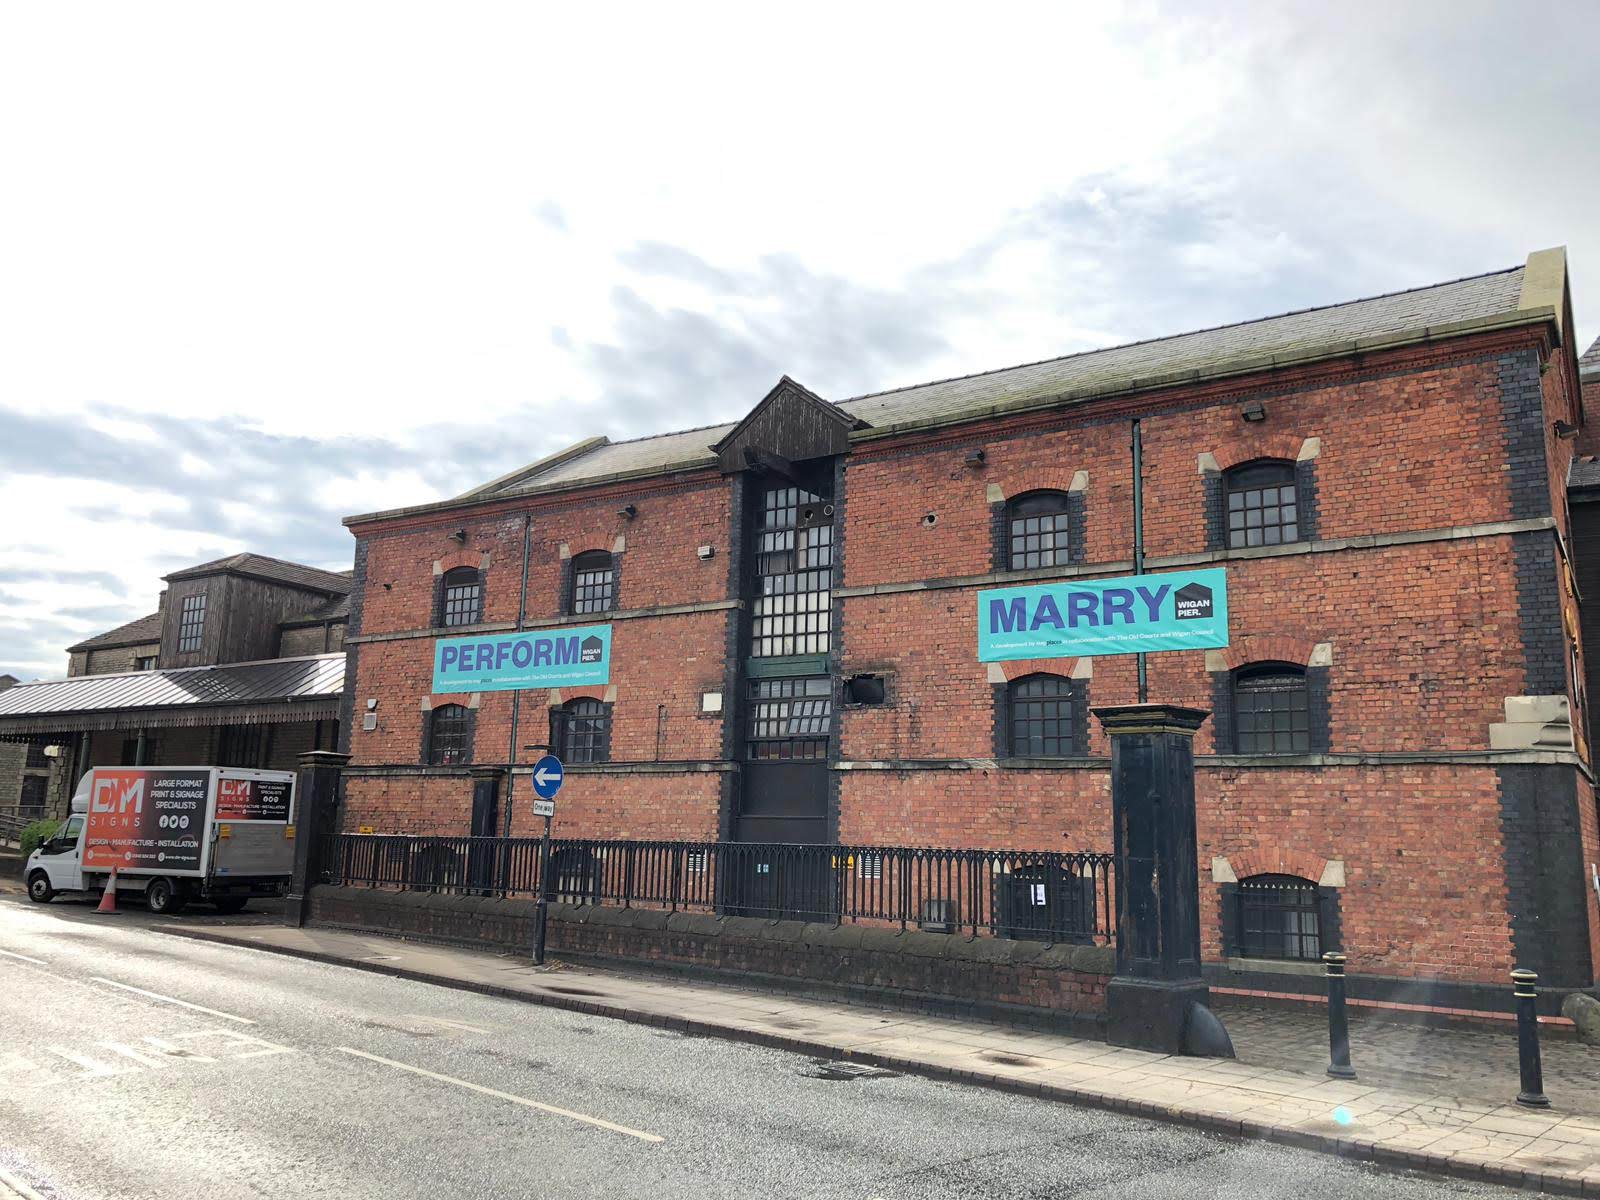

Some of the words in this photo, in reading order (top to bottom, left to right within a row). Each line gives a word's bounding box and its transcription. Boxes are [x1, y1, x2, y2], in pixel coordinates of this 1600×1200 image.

[990, 584, 1172, 634] MARRY
[1177, 600, 1210, 609] WIGAN
[1178, 609, 1201, 617] PIER.
[441, 636, 580, 673] PERFORM
[154, 779, 175, 788] LARGE
[176, 779, 203, 788] FORMAT
[93, 778, 145, 813] DM
[151, 790, 169, 798] PRINT
[175, 790, 204, 799] SIGNAGE
[155, 801, 197, 809] SPECIALISTS
[534, 803, 543, 811] One
[90, 816, 140, 827] SIGNS
[111, 838, 154, 847] MANUFACTURE
[158, 839, 199, 848] INSTALLATION
